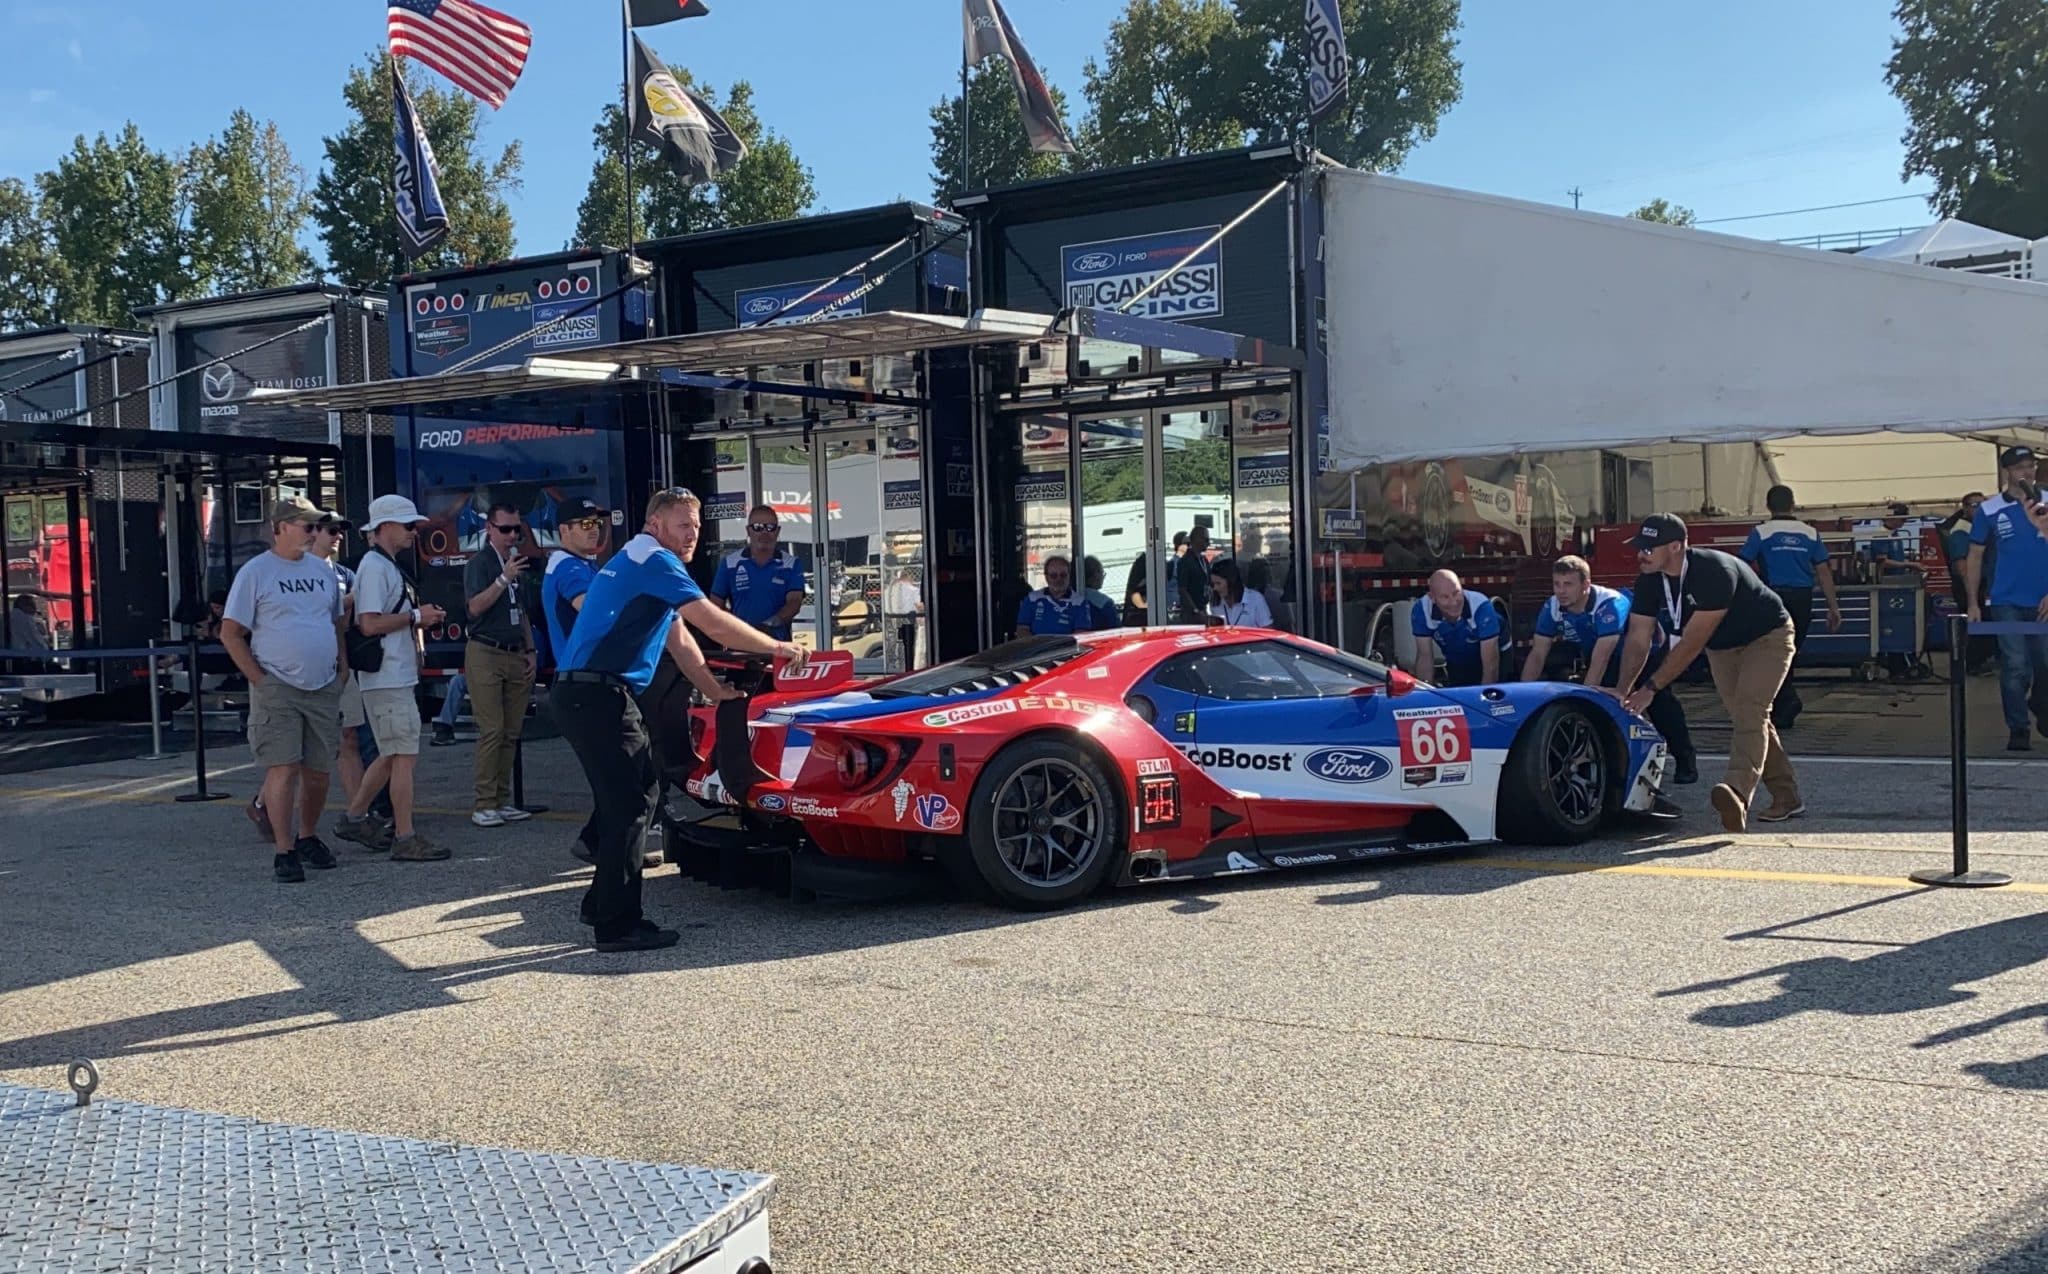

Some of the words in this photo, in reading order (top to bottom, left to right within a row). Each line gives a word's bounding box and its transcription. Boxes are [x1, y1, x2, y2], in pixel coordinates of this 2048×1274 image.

[1079, 254, 1108, 270] Ford
[1125, 252, 1147, 262] FORD
[1071, 284, 1094, 308] CHIP
[1096, 268, 1215, 305] GANASSI
[490, 292, 532, 309] IMSA
[750, 300, 774, 313] Ford
[1103, 295, 1215, 317] CING
[547, 317, 596, 334] GANASSI
[537, 329, 597, 343] RACING
[254, 379, 285, 389] TEAM
[289, 376, 324, 388] JOEST
[23, 412, 48, 423] TEAM
[419, 429, 462, 448] FORD
[1024, 483, 1064, 495] GANASSI
[1241, 478, 1289, 486] RACIN
[278, 578, 326, 594] NAVY
[947, 702, 1011, 723] Castrol
[1396, 708, 1461, 719] WeatherTech
[1411, 718, 1460, 764] 66
[1139, 760, 1170, 773] GTLM
[1321, 751, 1375, 778] Ford
[762, 795, 784, 809] Ford
[791, 804, 839, 818] EcoBoost
[916, 793, 948, 828] VP
[1291, 853, 1337, 865] brembo
